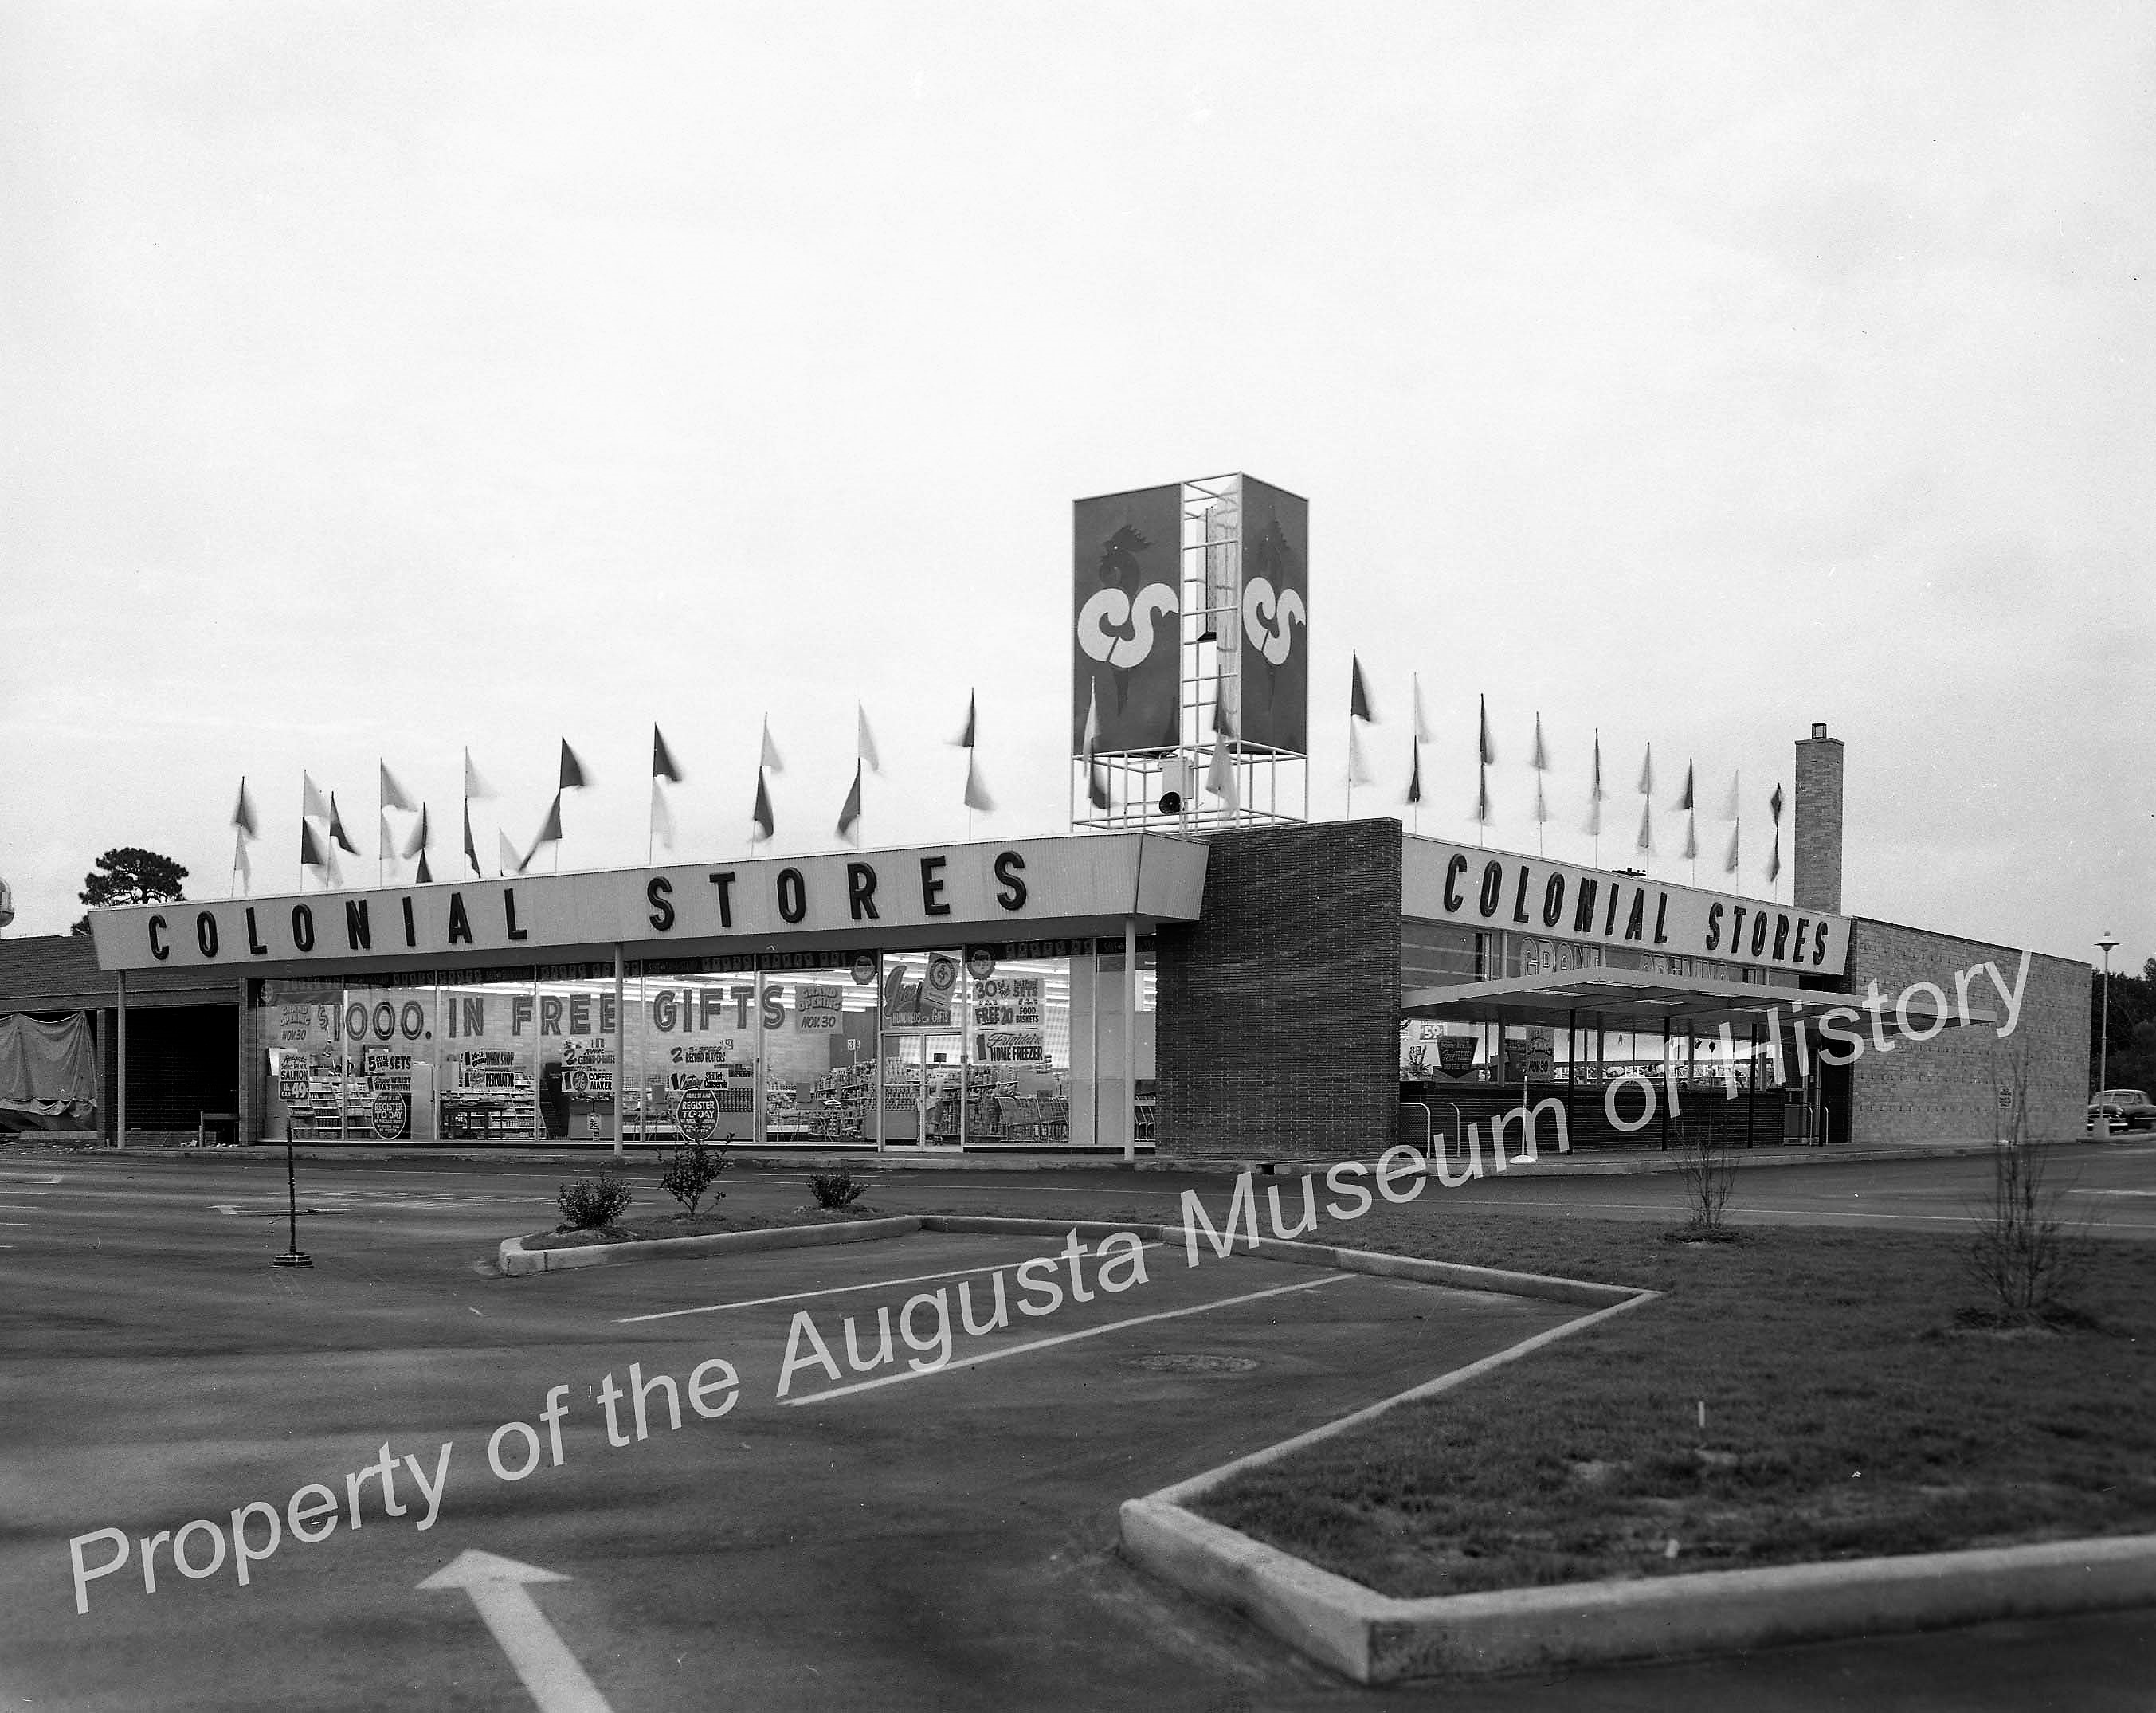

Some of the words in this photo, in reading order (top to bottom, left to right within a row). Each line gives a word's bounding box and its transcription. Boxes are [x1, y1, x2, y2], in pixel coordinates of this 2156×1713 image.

[149, 888, 527, 960] COLONIAL
[647, 850, 1027, 931] STORES
[1444, 853, 1668, 943] COLONIAL
[1707, 902, 1829, 965] STORES
[975, 980, 997, 998] 30
[449, 998, 483, 1038] IN
[512, 994, 616, 1036] FREE
[653, 986, 786, 1033] GIFTS
[975, 1007, 1000, 1025] FREE
[821, 1016, 836, 1028] 30
[564, 1049, 577, 1065] 2
[670, 1046, 683, 1063] 2
[990, 1046, 1011, 1061] HOME
[1013, 1046, 1043, 1061] FREEZER
[368, 1056, 376, 1071] 5
[390, 1056, 411, 1069] SETS
[280, 1070, 308, 1080] SALMON
[590, 1081, 612, 1090] MAKER
[682, 1101, 715, 1110] REGISTER
